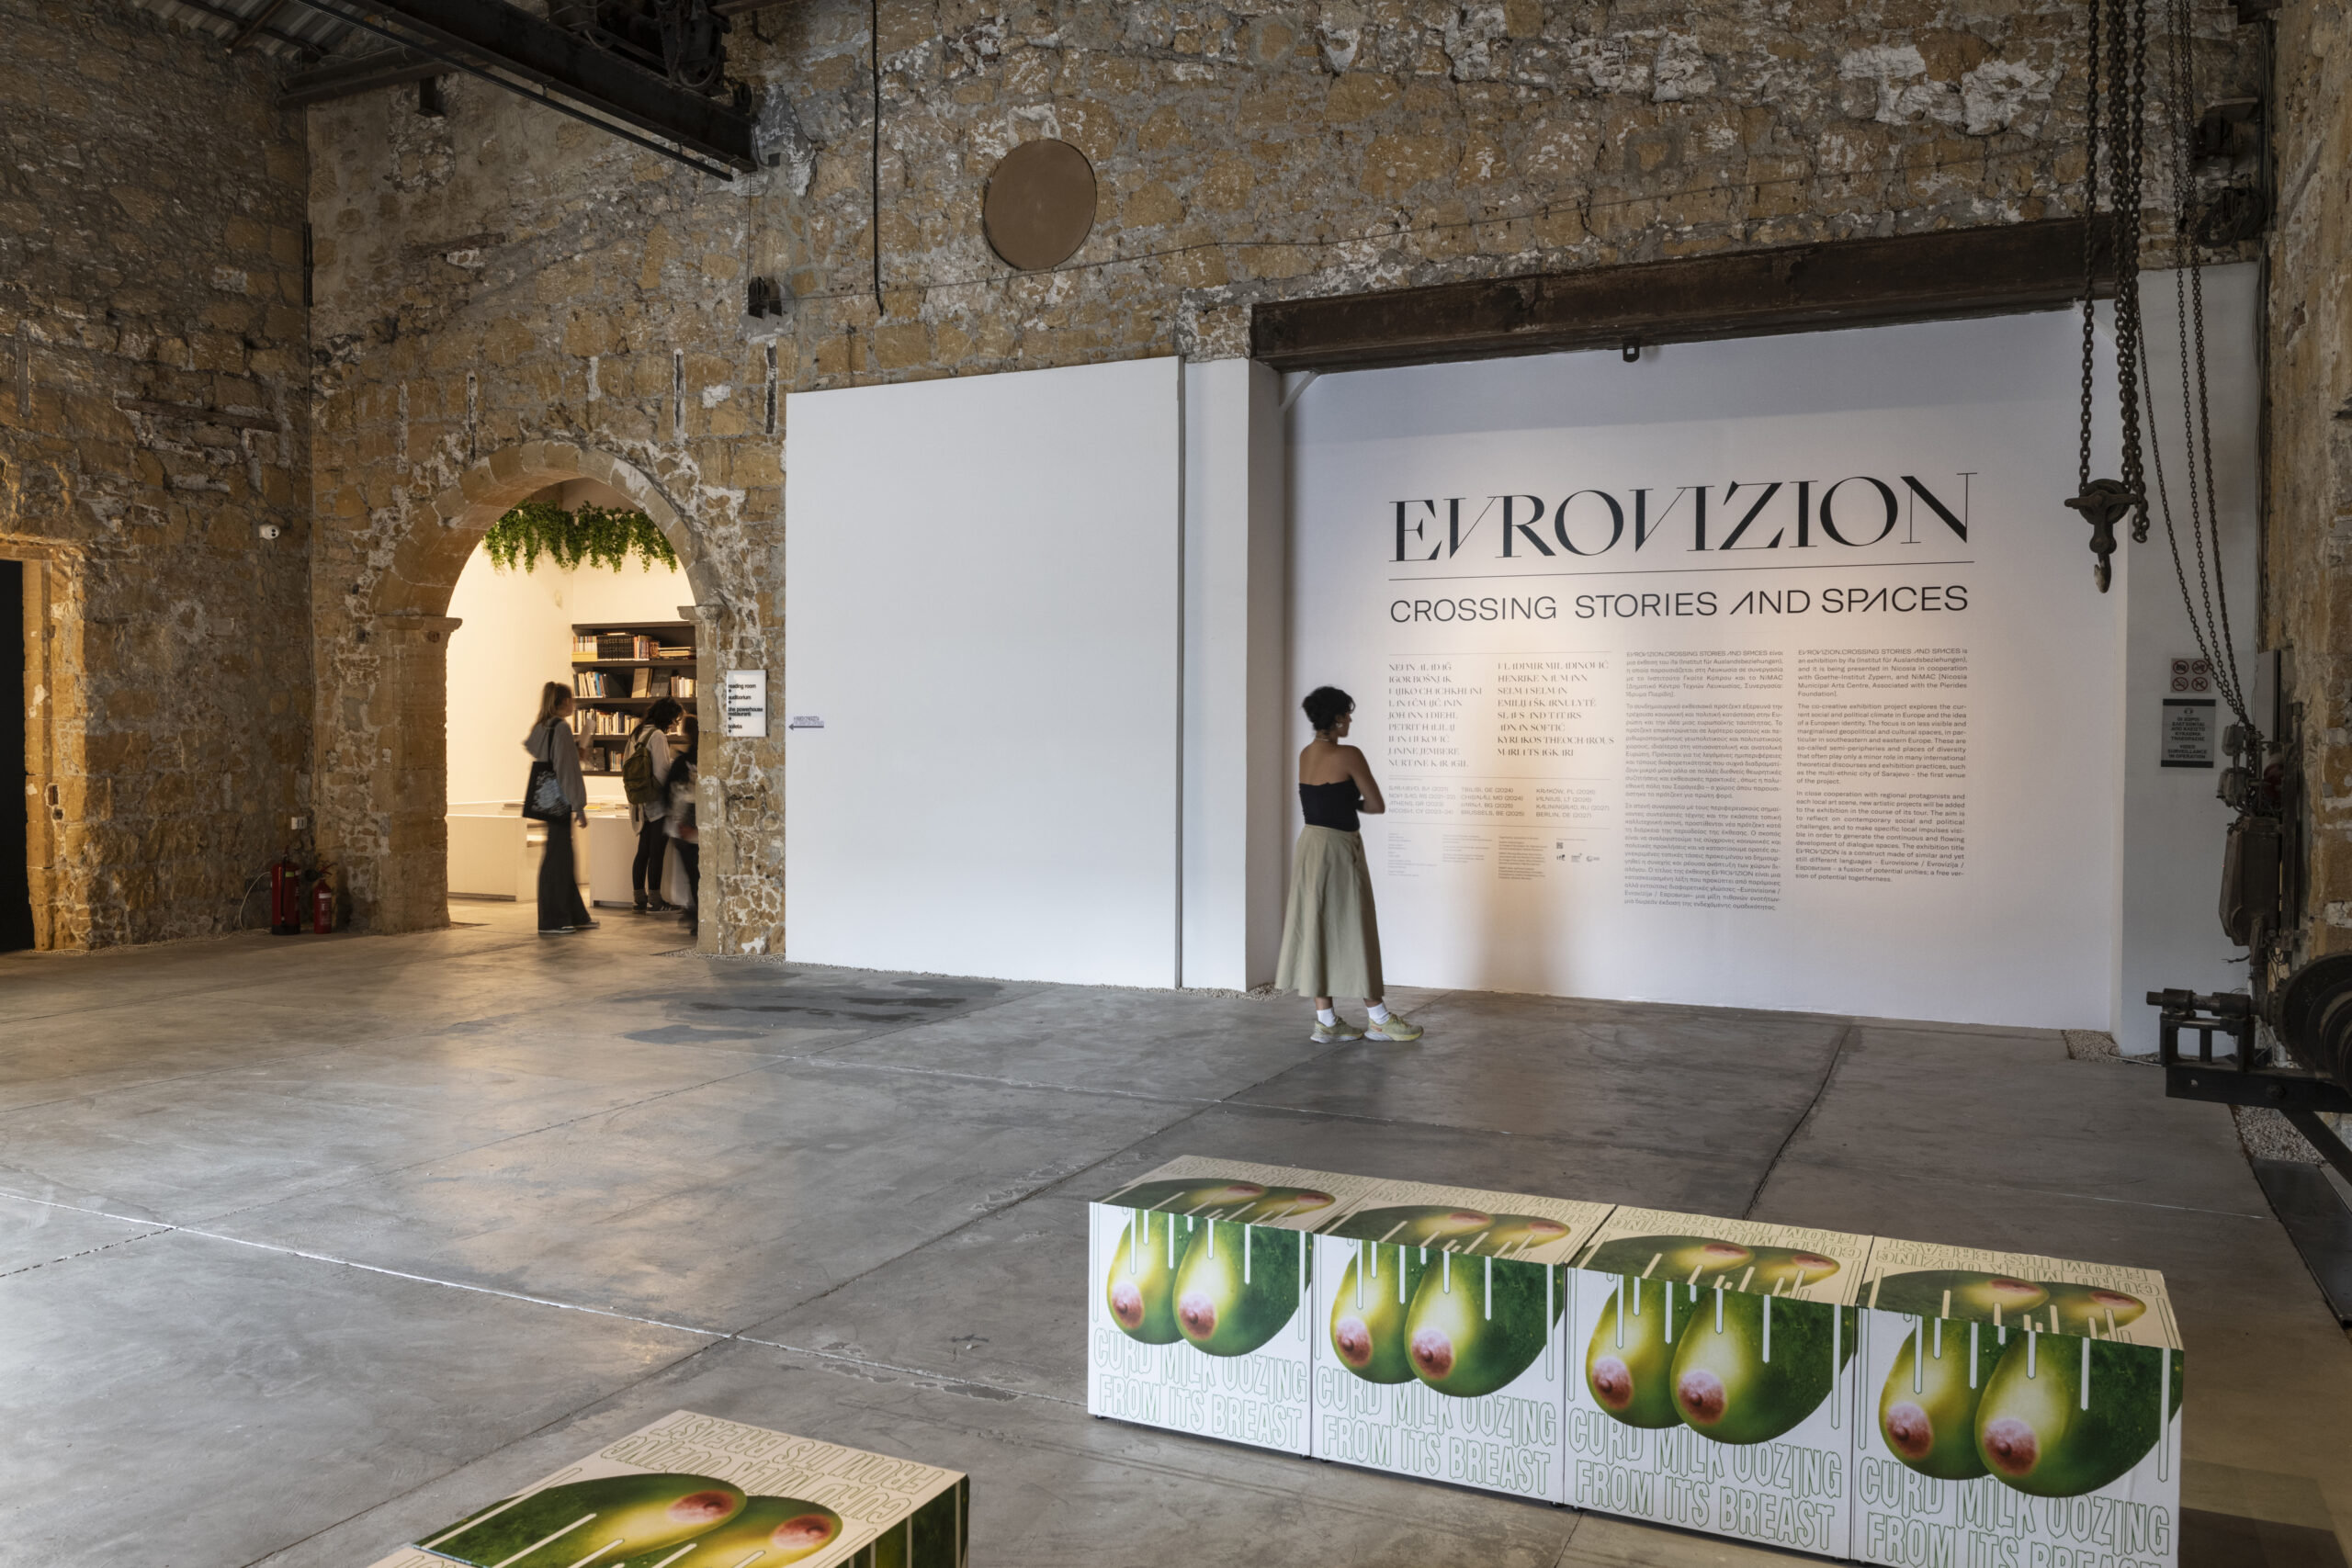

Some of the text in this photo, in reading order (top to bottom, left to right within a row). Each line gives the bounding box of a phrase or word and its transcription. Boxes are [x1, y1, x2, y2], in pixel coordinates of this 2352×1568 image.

[1389, 473, 1977, 562] EVROVIZION
[1390, 585, 1968, 623] CROSSING STORIES AND SPACES
[1094, 1327, 1307, 1404] CURD MILK OOZING
[1100, 1374, 1302, 1449] FROM ITS BREAST
[1316, 1366, 1556, 1448] CURD MILK OOZING
[1323, 1415, 1551, 1495] FROM ITS BREAST
[1568, 1407, 1842, 1499] CURD MILK OOZING
[1576, 1459, 1835, 1551] FROM ITS BREAST
[1860, 1457, 1944, 1518] CURD
[1956, 1476, 2036, 1540] MILK
[2046, 1493, 2170, 1556] OOZING
[1867, 1512, 1956, 1568] FROM
[1968, 1529, 2019, 1568] ITS
